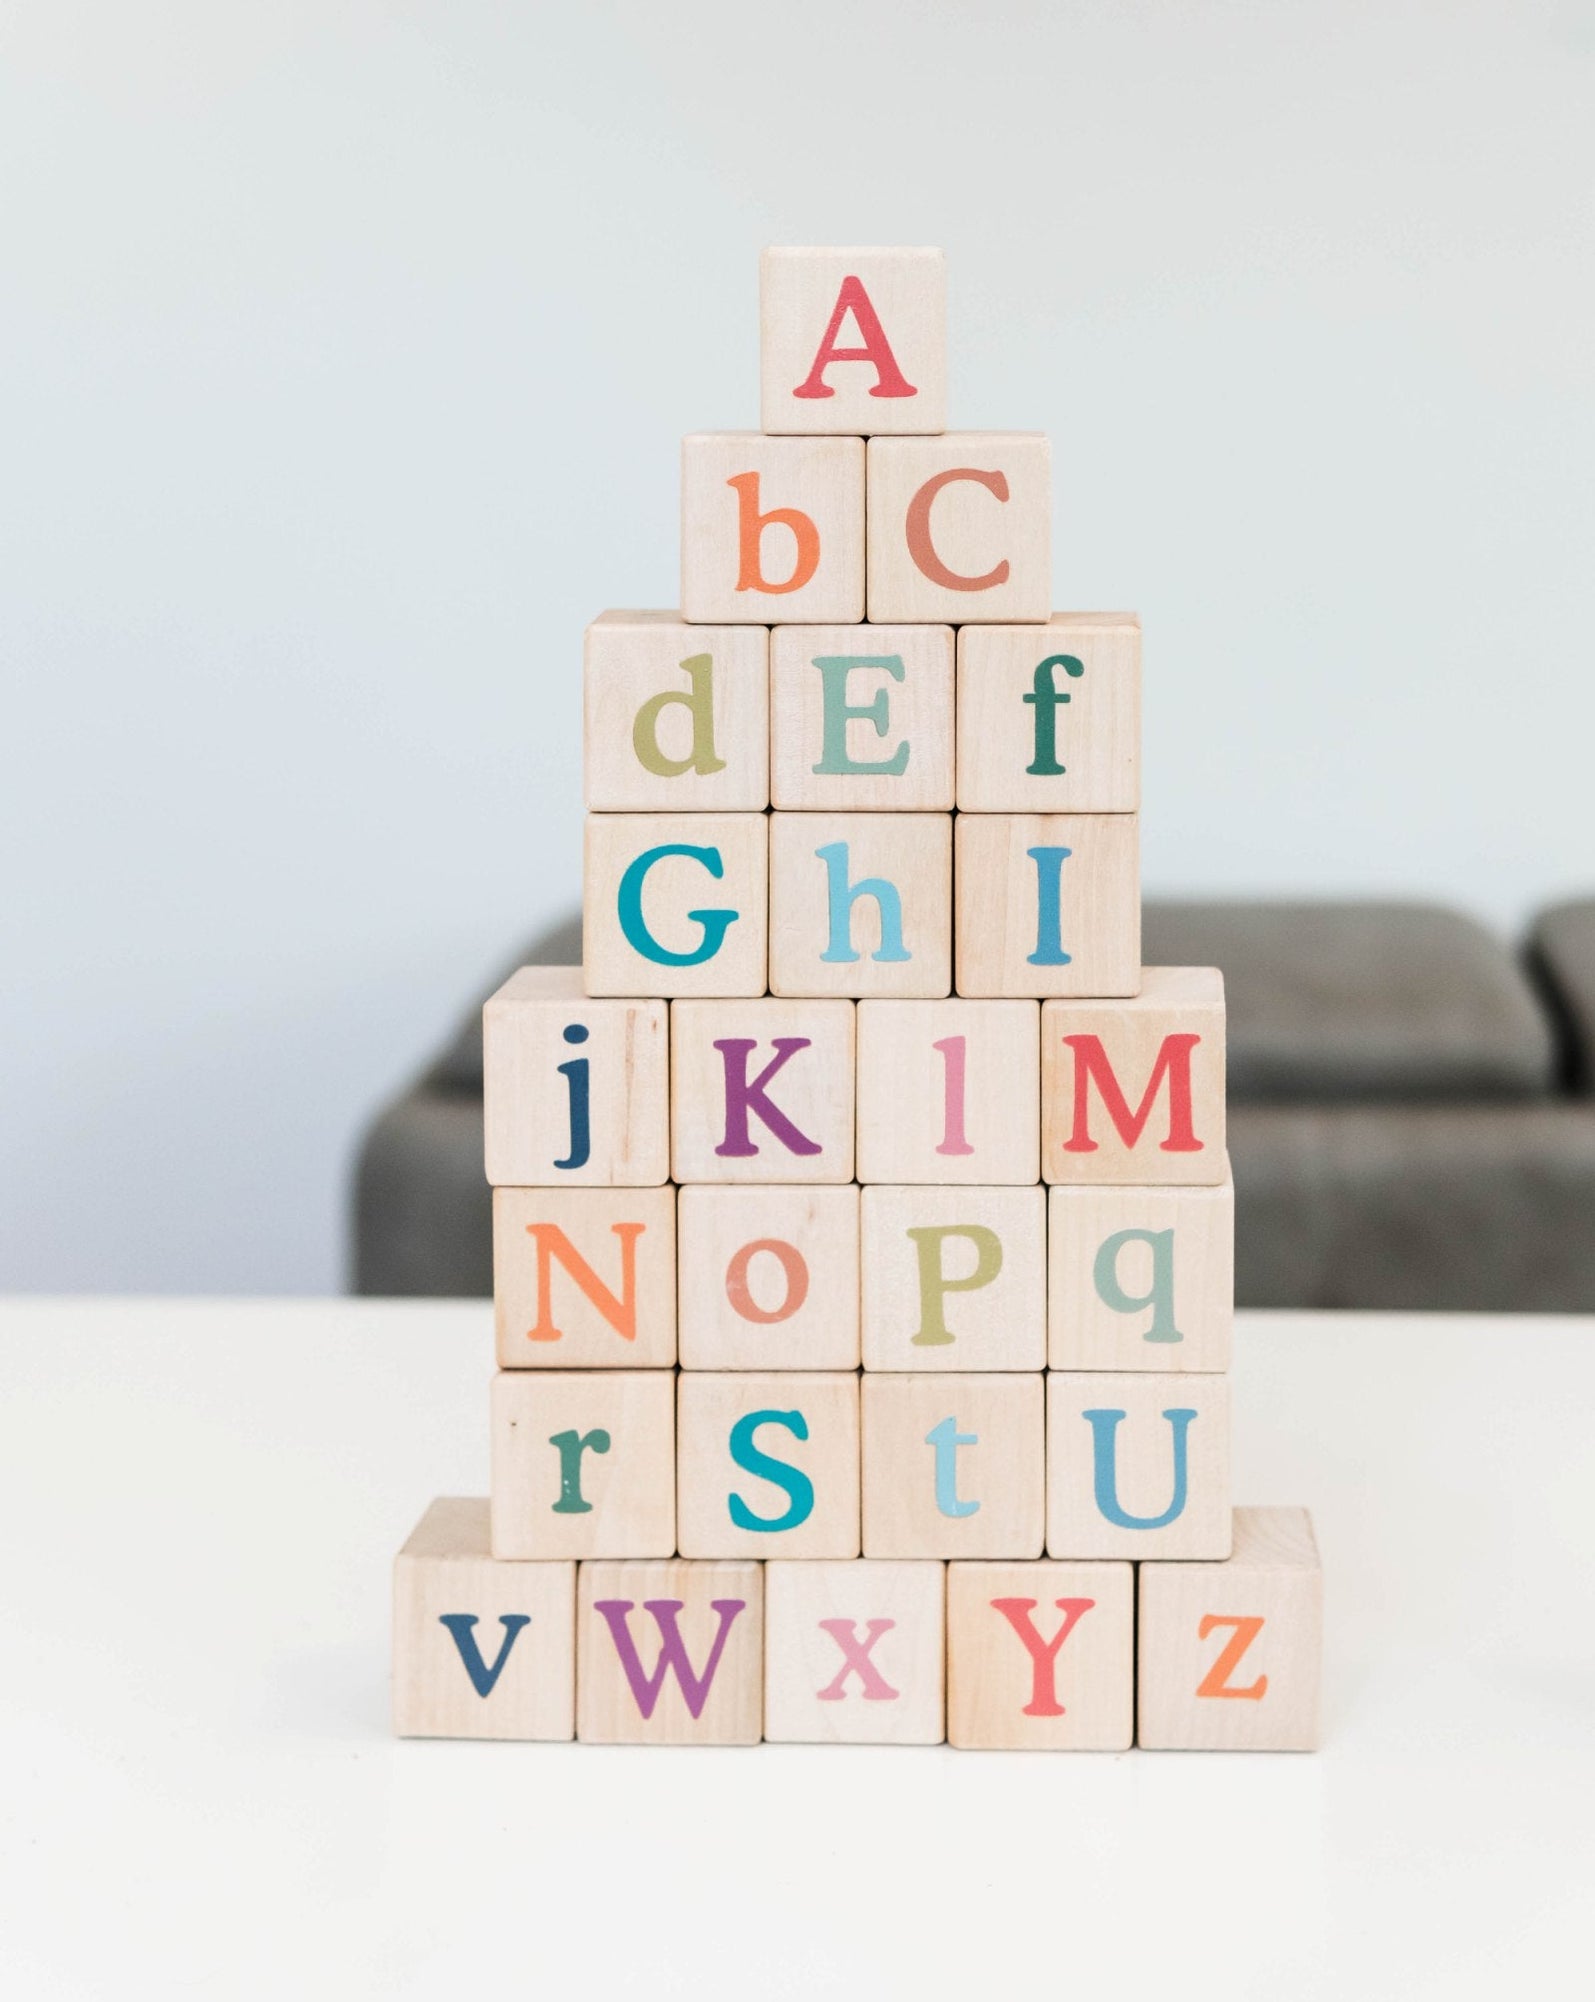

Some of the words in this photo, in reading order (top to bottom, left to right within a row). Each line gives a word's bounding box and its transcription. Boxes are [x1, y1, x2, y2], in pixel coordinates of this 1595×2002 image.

[792, 275, 918, 399] A
[726, 471, 820, 595] b
[906, 468, 1009, 592] C
[633, 653, 726, 777] d
[811, 655, 910, 776] E
[1023, 654, 1084, 776] f
[617, 844, 739, 967] G
[815, 841, 911, 962] h
[1027, 847, 1072, 966] I
[553, 1024, 590, 1170] j
[713, 1037, 823, 1158] K
[1062, 1034, 1204, 1153] M
[526, 1223, 645, 1341] N
[907, 1225, 1002, 1345] P
[1094, 1229, 1183, 1343] q
[549, 1429, 611, 1514] r
[728, 1409, 814, 1533] S
[926, 1416, 978, 1519] t
[1082, 1409, 1198, 1530] U
[438, 1613, 532, 1699] v
[593, 1599, 746, 1720] W
[817, 1619, 899, 1700] x
[990, 1597, 1095, 1717] Y
[1196, 1614, 1268, 1700] z
